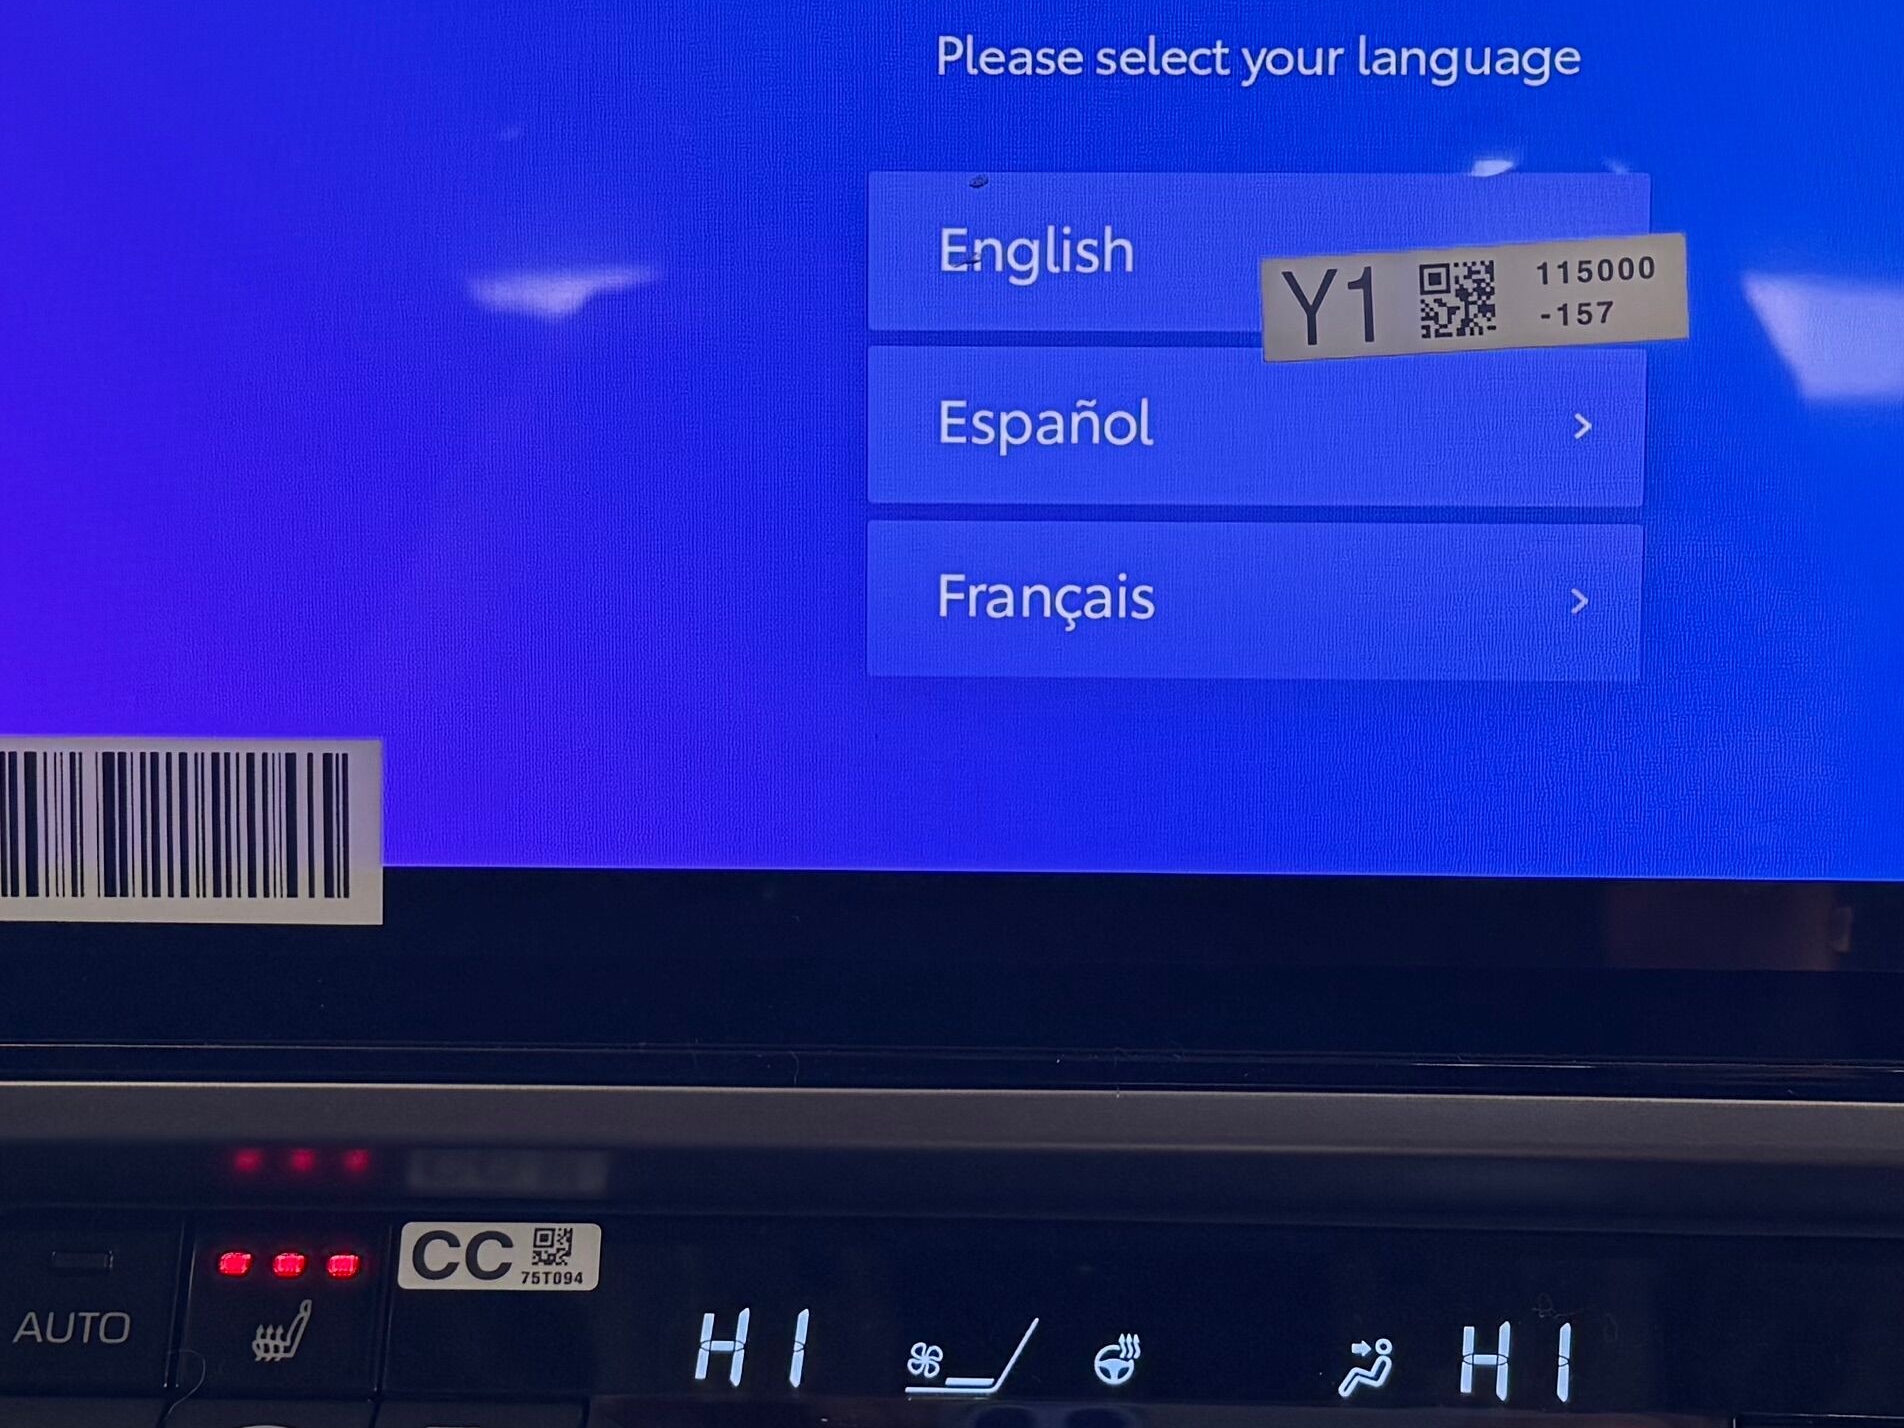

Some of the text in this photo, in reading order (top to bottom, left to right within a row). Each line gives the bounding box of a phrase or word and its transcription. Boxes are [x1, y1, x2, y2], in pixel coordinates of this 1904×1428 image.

[937, 34, 1582, 87] Please select your language
[940, 225, 1134, 286] English
[1536, 256, 1656, 286] 115000
[1281, 266, 1376, 346] Y1
[1540, 300, 1615, 326] -157
[940, 397, 1155, 456] Español
[938, 573, 1156, 632] Français
[411, 1229, 514, 1281] CC
[521, 1270, 584, 1285] 75T094
[12, 1312, 131, 1345] AUTO
[695, 1307, 810, 1389] HI
[1459, 1320, 1572, 1403] HI
